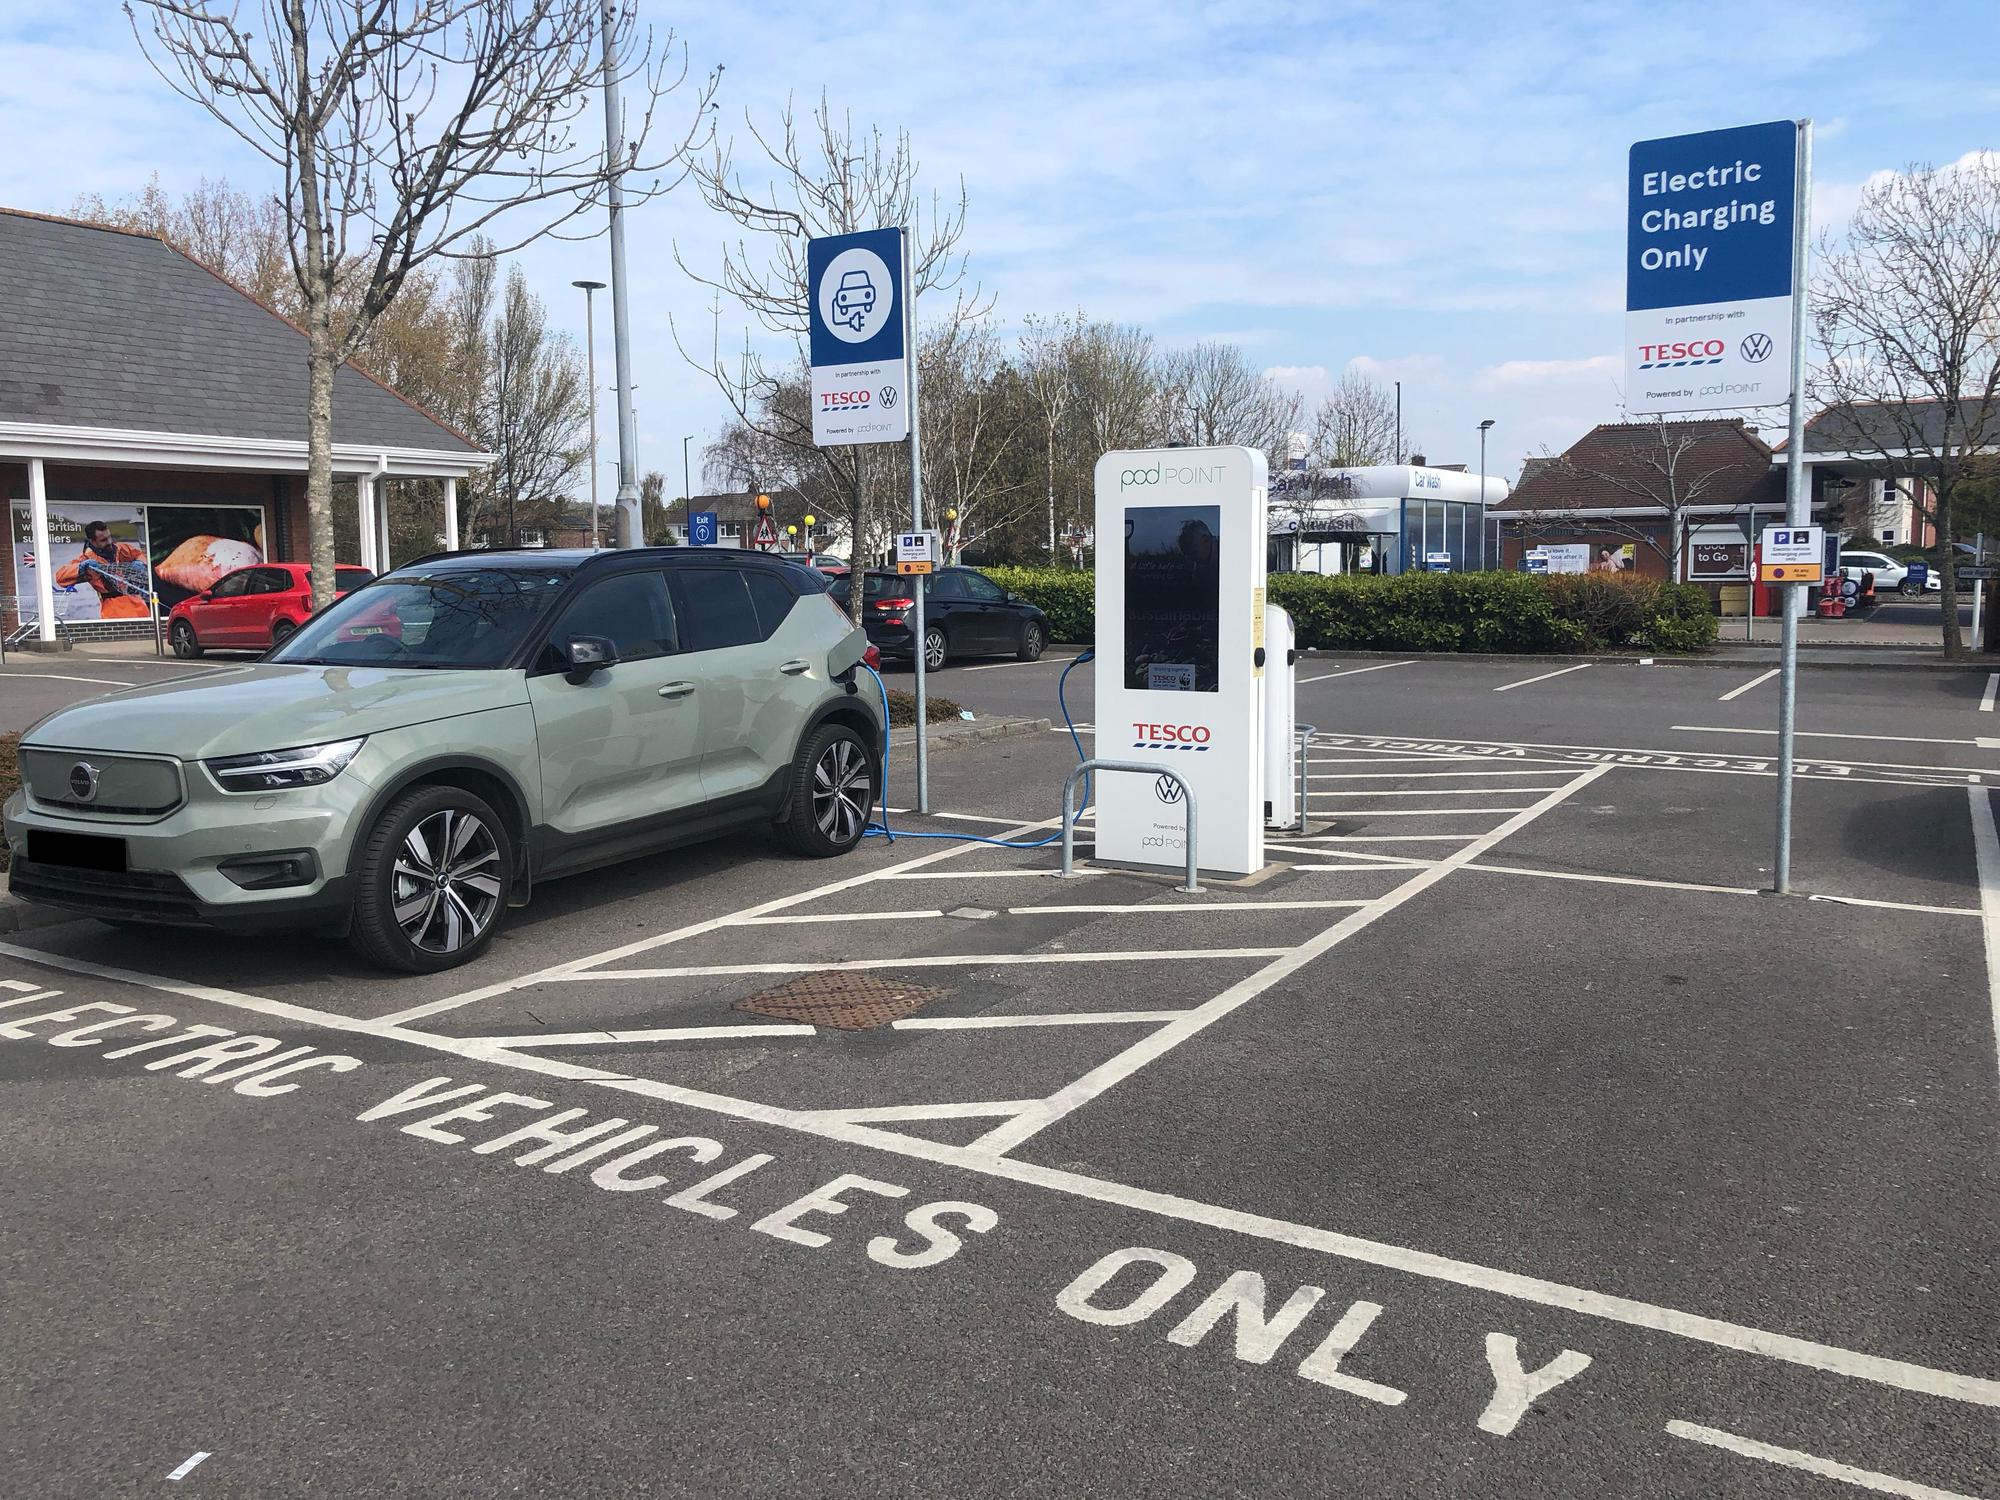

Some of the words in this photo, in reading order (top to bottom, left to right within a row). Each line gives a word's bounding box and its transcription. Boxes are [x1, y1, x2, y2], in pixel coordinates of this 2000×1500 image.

[1643, 160, 1762, 196] Electric
[1641, 200, 1775, 233] Charging
[1640, 244, 1709, 271] Only
[1676, 312, 1725, 324] partnership
[1727, 310, 1745, 319] with
[1639, 340, 1725, 361] TESCO
[841, 369, 869, 378] partnership
[821, 390, 871, 406] TESCO
[1646, 390, 1681, 399] Powered
[1683, 389, 1693, 398] by
[1725, 382, 1762, 395] POINT
[1121, 461, 1160, 493] pod
[1165, 465, 1227, 485] POINT
[1414, 471, 1425, 487] Car
[1426, 473, 1441, 489] Wash
[49, 522, 81, 532] British
[696, 516, 709, 524] Exit
[22, 534, 71, 543] suliers
[1698, 553, 1709, 562] to
[1712, 552, 1729, 562] Go
[1133, 724, 1211, 743] TESCO
[1153, 823, 1177, 831] Powered
[1142, 835, 1164, 849] pod
[356, 1076, 998, 1269] VEHICLES
[1056, 1246, 1593, 1437] ONLY
